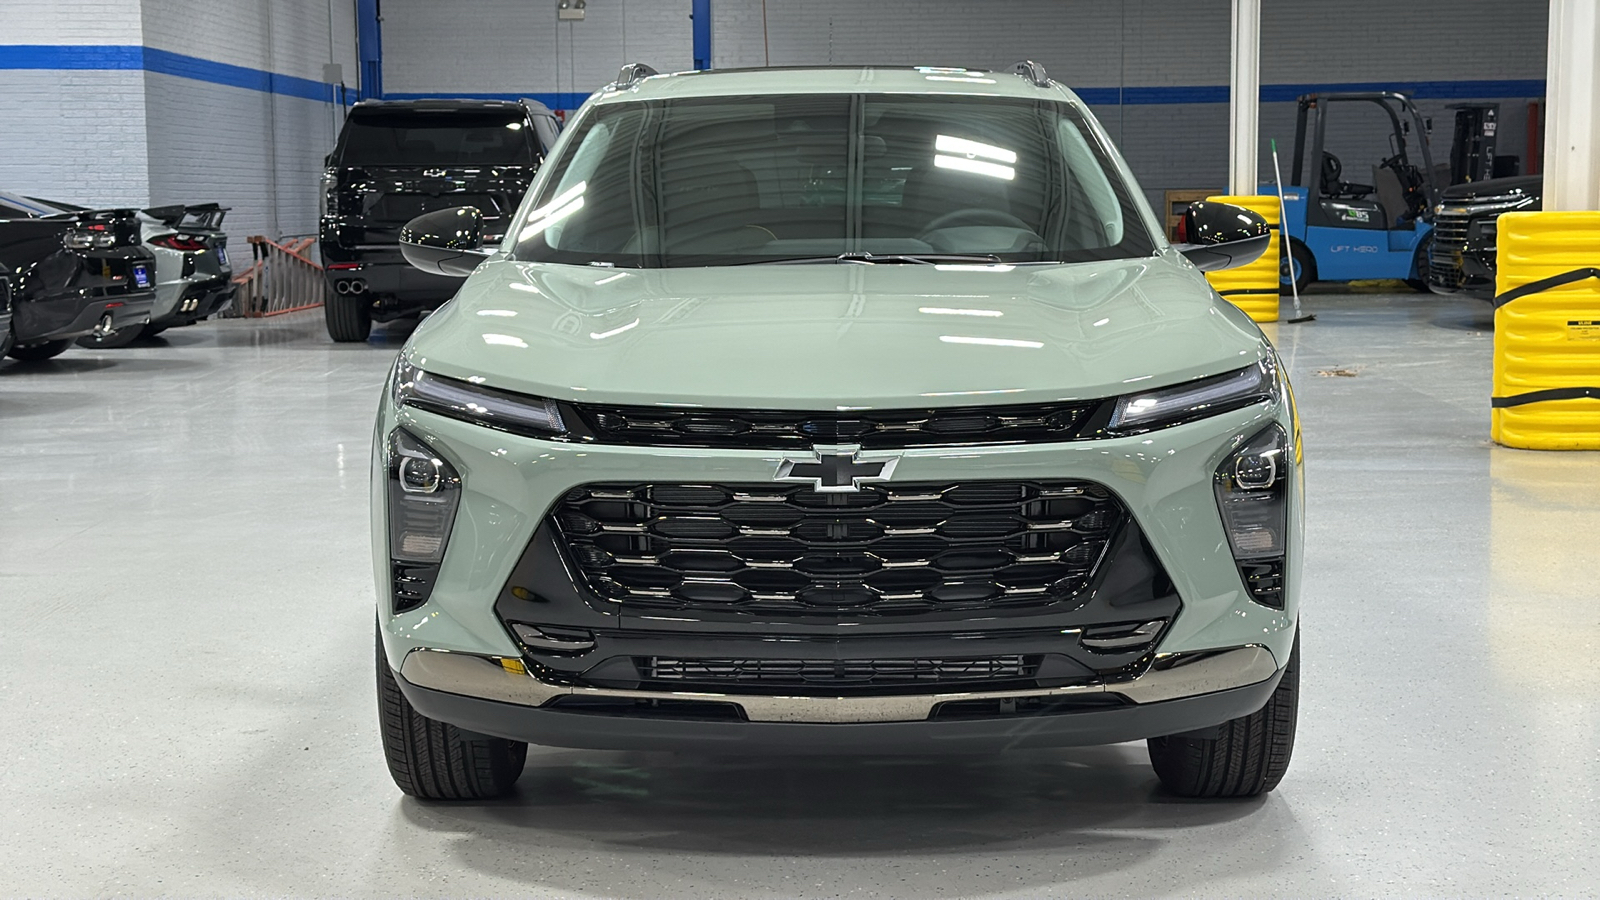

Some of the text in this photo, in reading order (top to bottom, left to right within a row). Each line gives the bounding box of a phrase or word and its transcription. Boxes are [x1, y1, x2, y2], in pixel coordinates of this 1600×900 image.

[1485, 146, 1493, 166] LIFT
[1330, 245, 1378, 253] LIFT HERO
